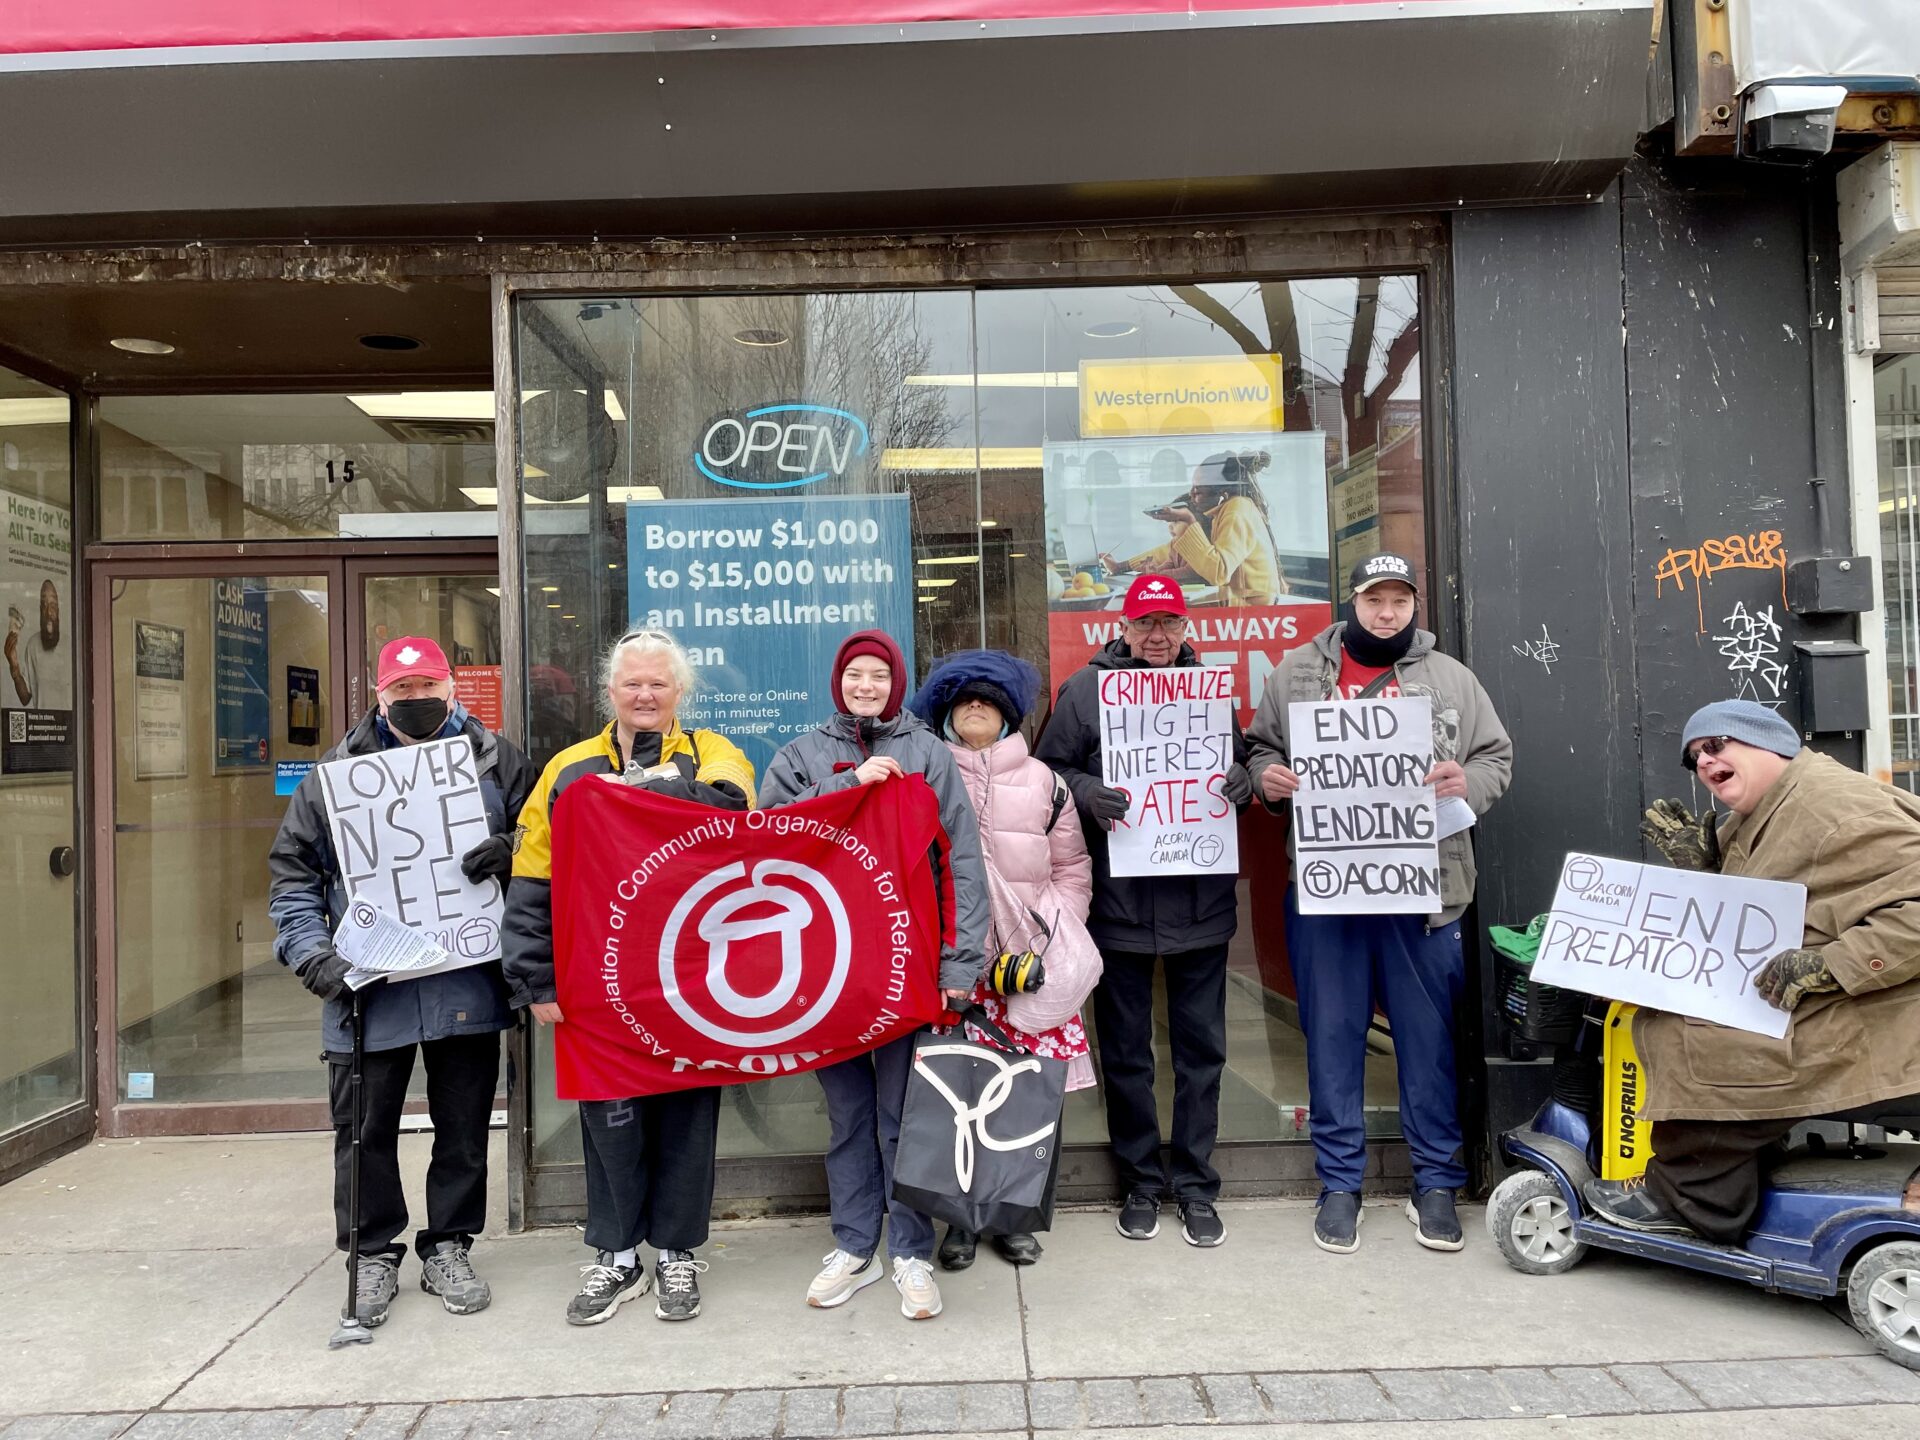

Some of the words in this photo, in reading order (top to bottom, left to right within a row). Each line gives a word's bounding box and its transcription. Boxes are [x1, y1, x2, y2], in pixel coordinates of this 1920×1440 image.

[702, 418, 855, 475] OPEN
[325, 461, 355, 484] 15
[8, 496, 36, 520] Here
[38, 506, 54, 526] for
[56, 511, 70, 530] Yo
[8, 521, 24, 542] All
[26, 526, 46, 547] Tax
[645, 524, 762, 550] Borrow
[771, 518, 879, 549] $1,000
[645, 565, 679, 589] to
[687, 560, 814, 591] $15,000
[823, 557, 893, 585] with
[1365, 563, 1409, 576] WARS
[1370, 556, 1404, 567] STAR
[217, 581, 244, 606] CASH
[1138, 590, 1175, 601] Canada
[646, 608, 684, 628] an
[693, 598, 876, 628] Installment
[1186, 616, 1298, 643] ALWAYS
[695, 691, 746, 703] In-store
[749, 692, 763, 702] or
[766, 689, 808, 701] Online
[1101, 670, 1232, 706] CRIMINALIZE
[676, 707, 711, 720] cision
[715, 707, 726, 719] in
[730, 707, 781, 719] minutes
[778, 724, 791, 734] or
[1106, 703, 1209, 746] HIGH
[1313, 705, 1399, 743] END
[1108, 732, 1231, 783] INTEREST
[1292, 752, 1432, 792] PREDATORY
[322, 739, 476, 814] LOWER
[336, 786, 484, 875] NSF
[1295, 802, 1435, 843] LENDING
[745, 810, 878, 872] Organizations
[1150, 848, 1189, 865] CANADA
[1154, 830, 1194, 850] ACORN
[617, 816, 737, 901] Community
[873, 870, 899, 903] for
[1342, 863, 1440, 897] ACORN
[1594, 882, 1635, 899] ACORN
[1579, 891, 1621, 907] CANADA
[609, 902, 628, 931] of
[1640, 892, 1777, 955] END
[887, 909, 912, 1003] Reform
[1542, 919, 1768, 996] PREDATORY
[599, 936, 671, 1058] Association
